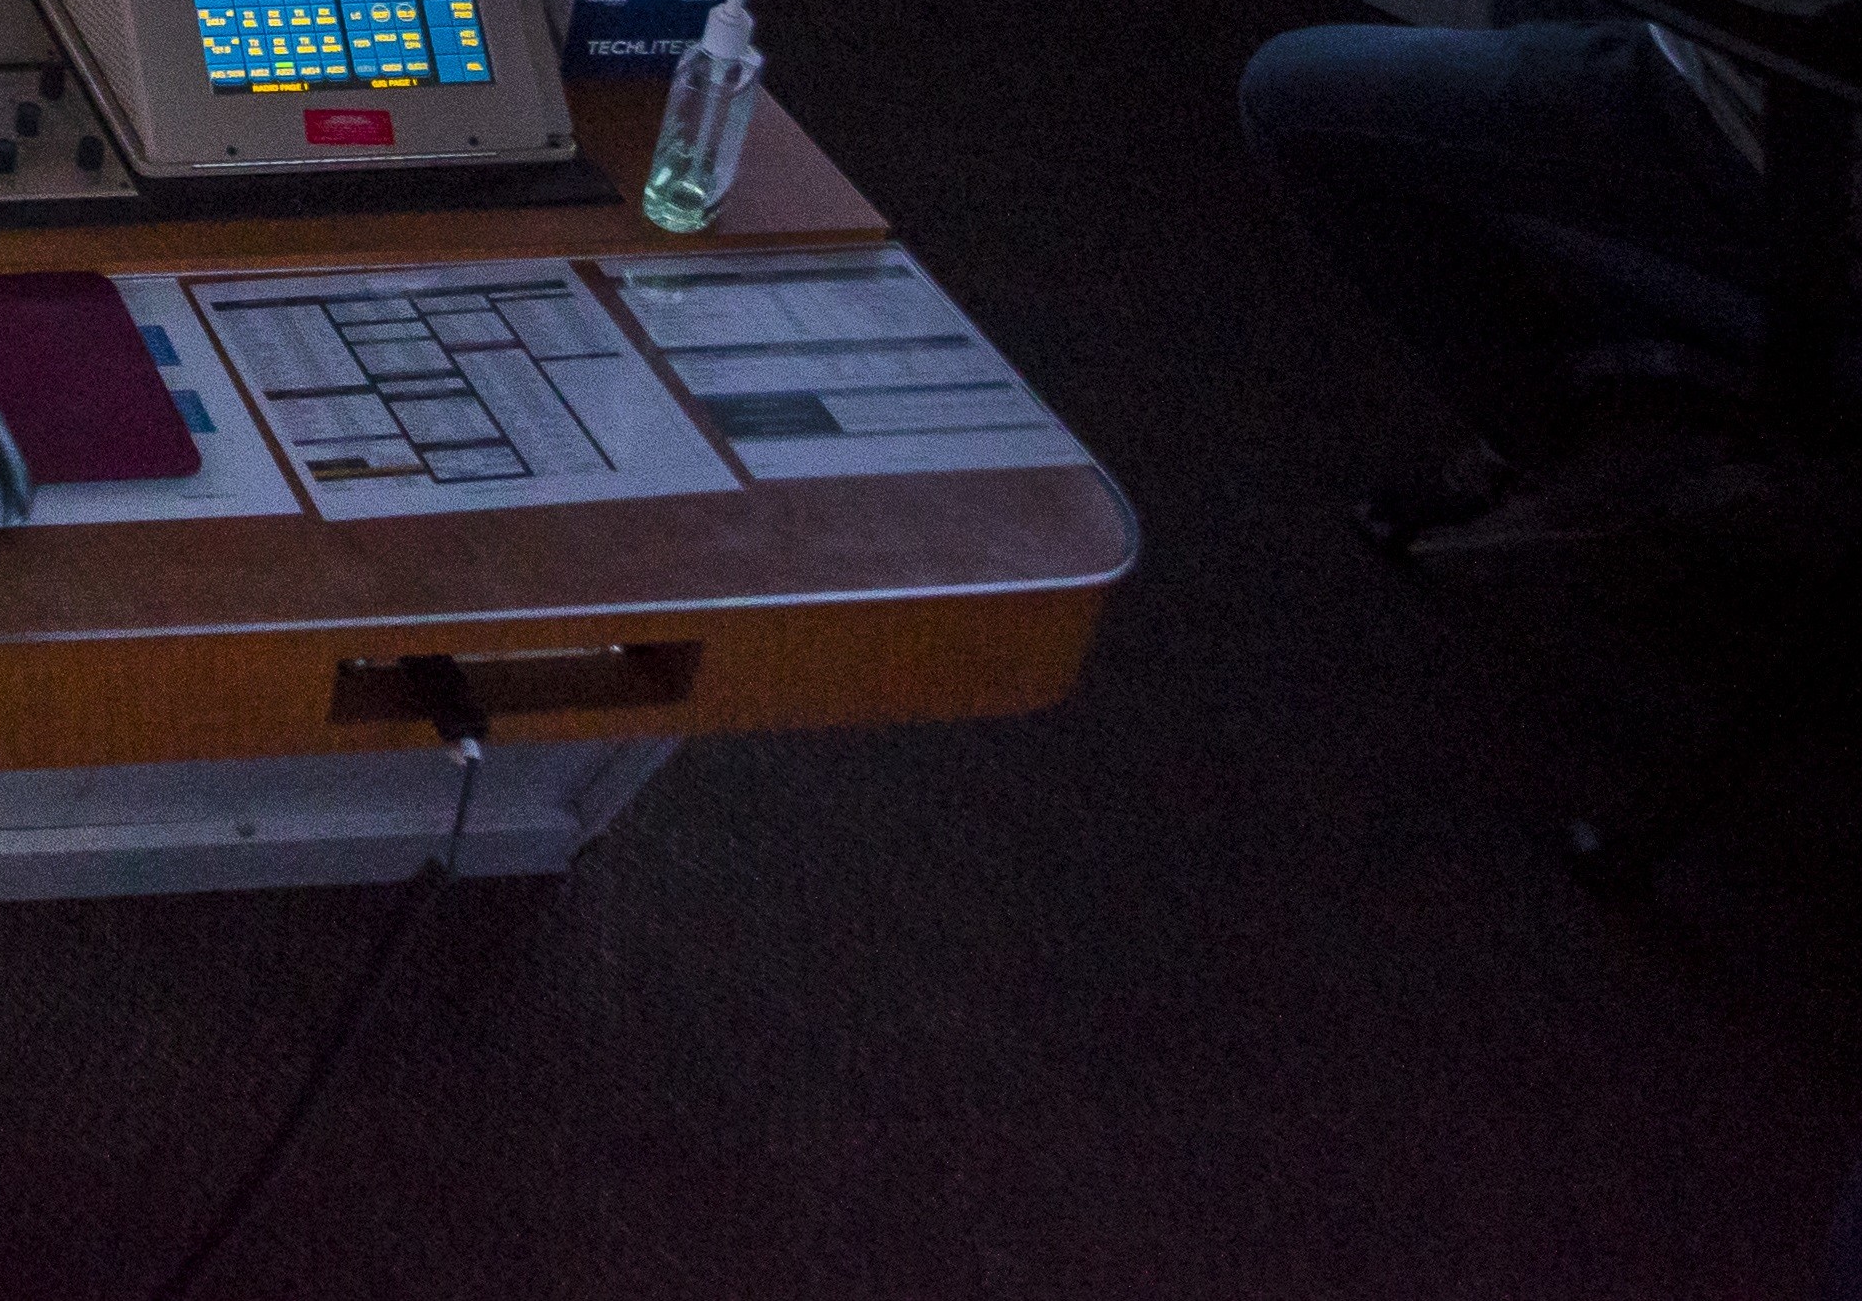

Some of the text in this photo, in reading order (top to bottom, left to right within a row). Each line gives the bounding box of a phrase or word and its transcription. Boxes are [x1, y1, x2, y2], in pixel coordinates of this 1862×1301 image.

[389, 79, 411, 87] PAGE
[253, 83, 279, 92] RADIO
[280, 83, 304, 91] PAGE
